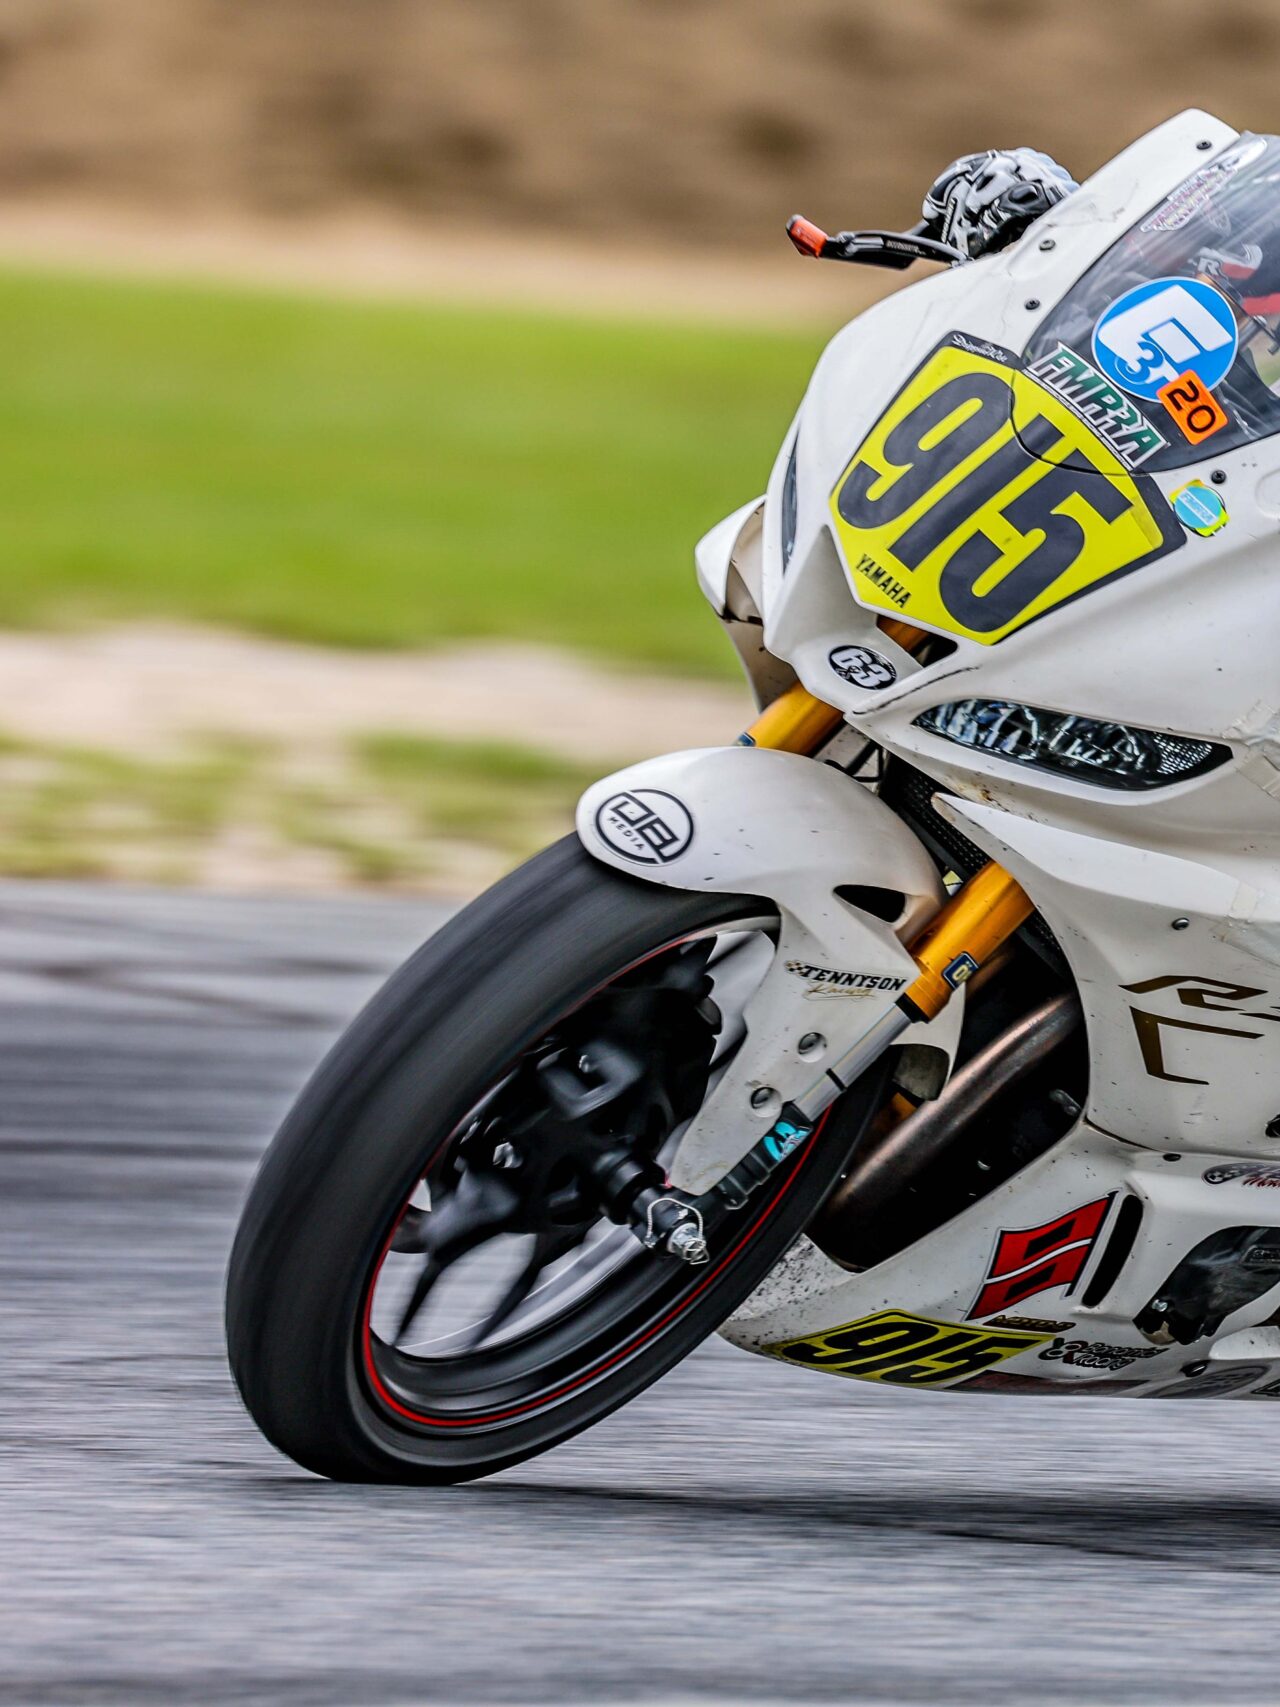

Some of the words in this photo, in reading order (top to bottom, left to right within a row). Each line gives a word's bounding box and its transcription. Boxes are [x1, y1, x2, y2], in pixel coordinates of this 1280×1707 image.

[1171, 381, 1218, 434] 20
[838, 372, 1134, 632] 915
[855, 553, 912, 609] YAMAHA
[830, 648, 892, 688] 63
[606, 815, 647, 852] MEDIA
[799, 964, 907, 992] TENNYSON
[785, 1321, 1034, 1384] 915
